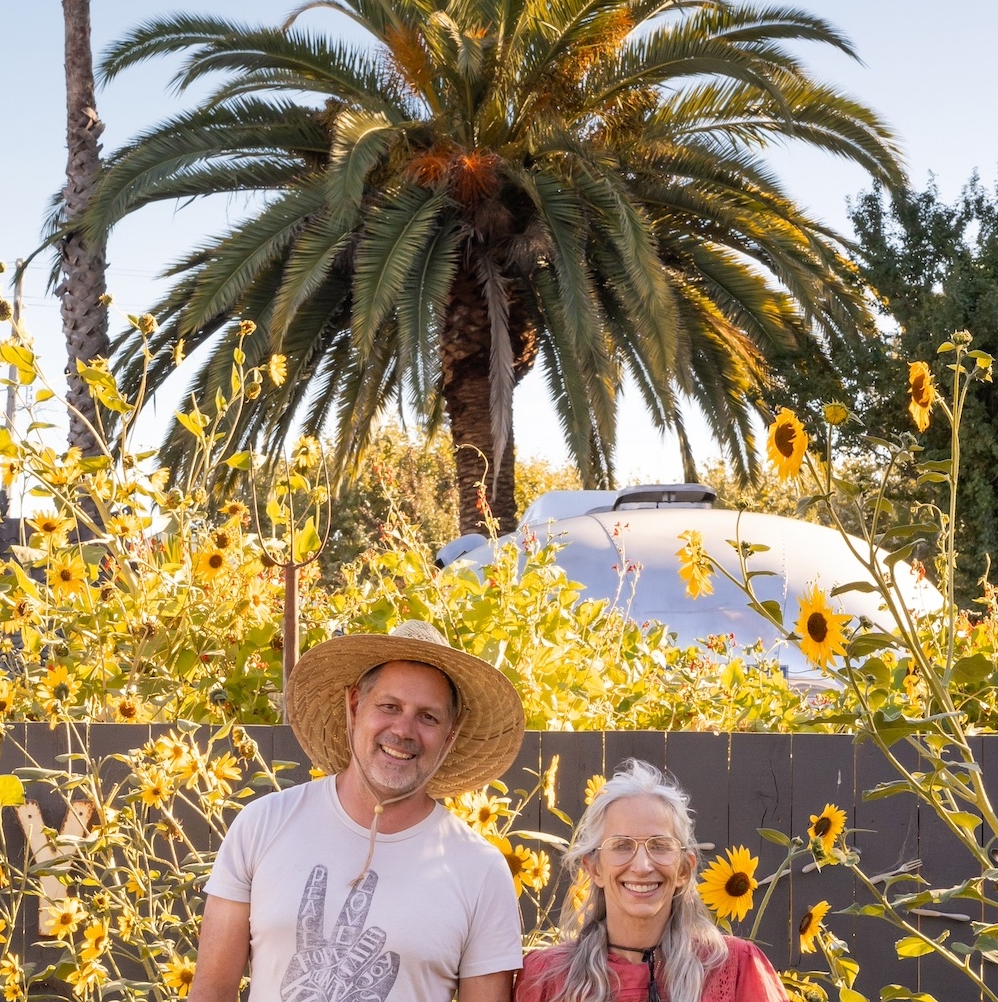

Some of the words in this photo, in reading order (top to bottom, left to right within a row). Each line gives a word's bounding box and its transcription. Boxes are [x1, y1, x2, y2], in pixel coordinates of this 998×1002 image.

[301, 867, 325, 948] PEACE
[335, 872, 374, 945] LOVE
[295, 947, 344, 972] HOPE
[339, 927, 386, 977] FAITH
[361, 951, 392, 986] JOY
